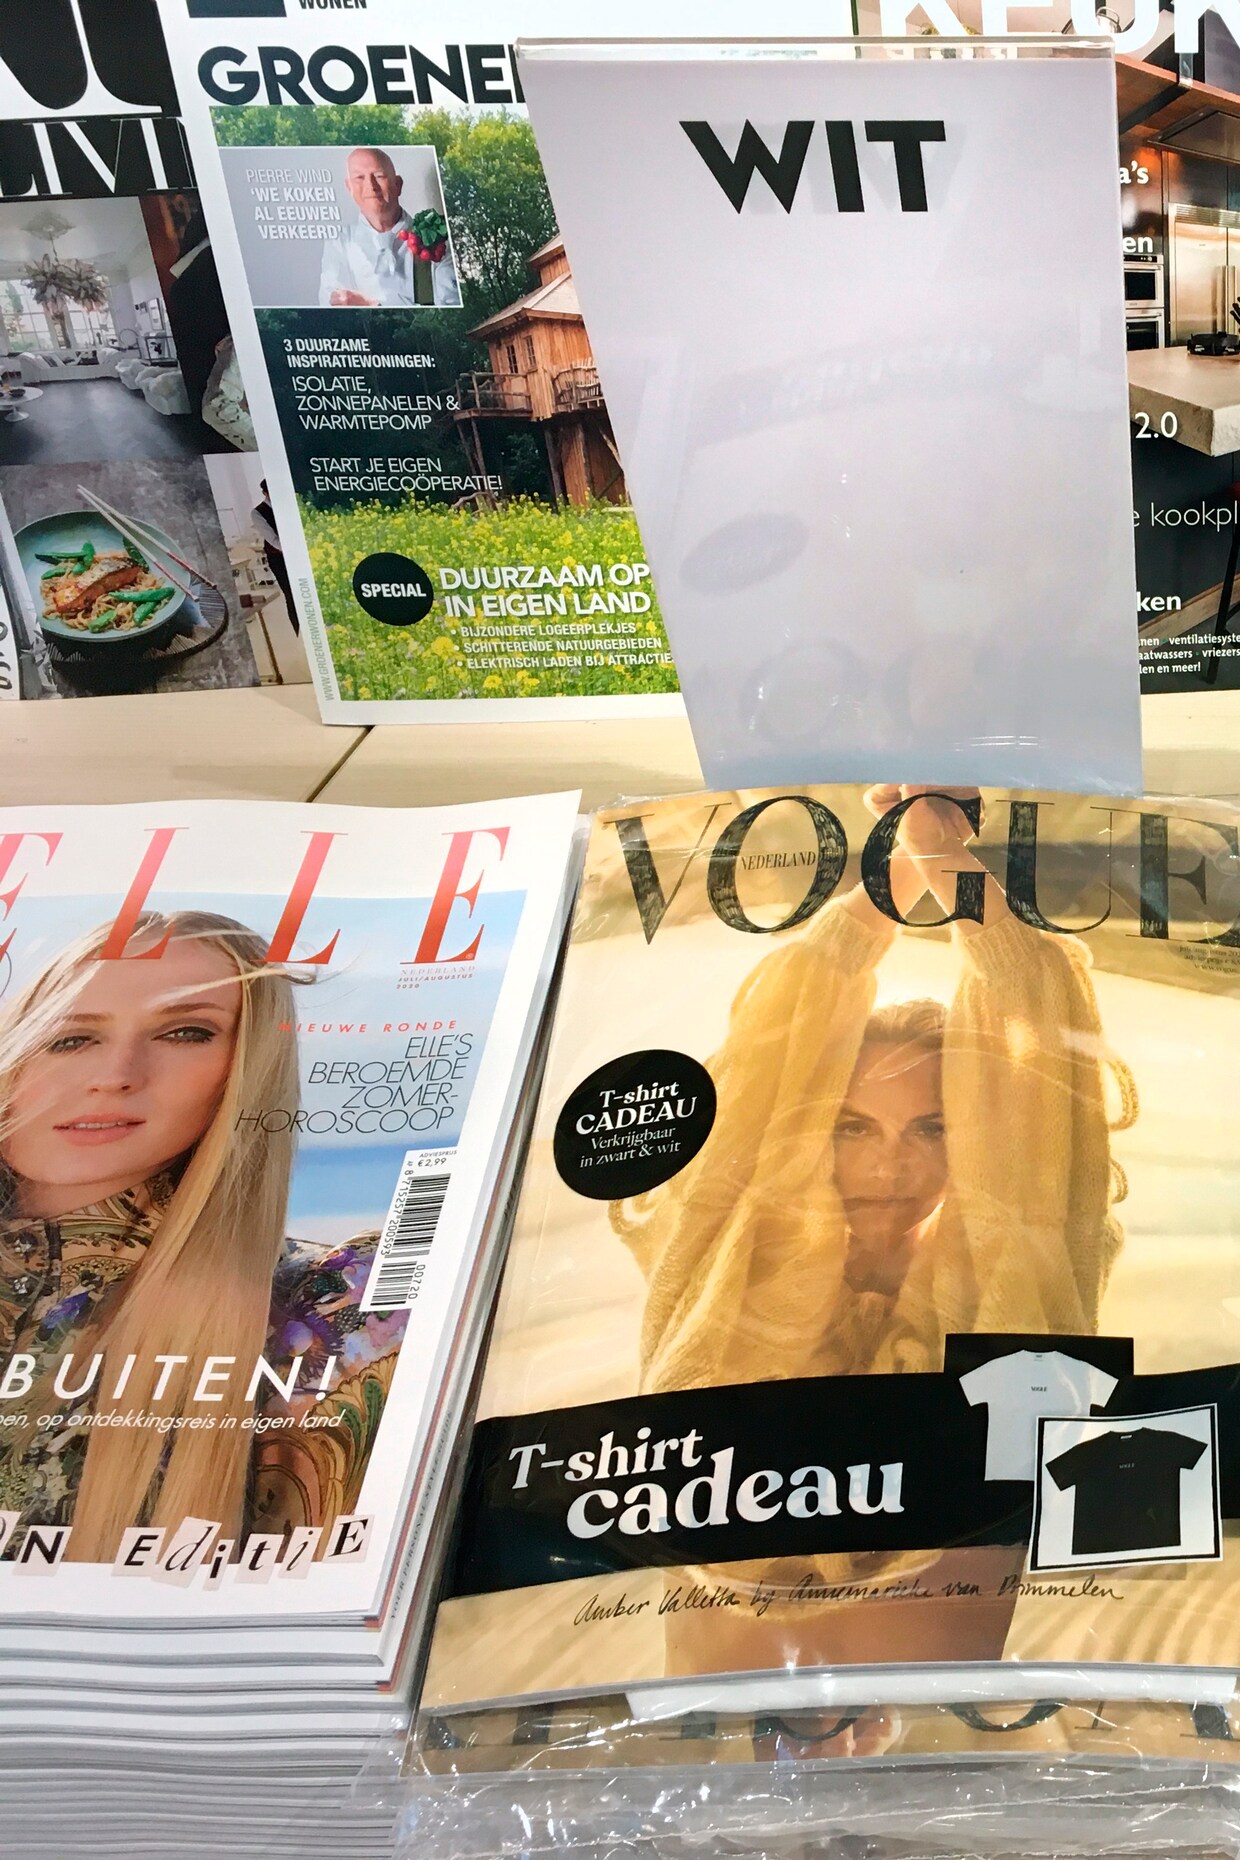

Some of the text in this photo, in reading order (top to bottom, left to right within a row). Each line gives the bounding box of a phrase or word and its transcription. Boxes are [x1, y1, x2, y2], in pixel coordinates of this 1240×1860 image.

[198, 45, 527, 105] GROENE
[246, 169, 333, 183] PIERRE WIND
[678, 118, 946, 214] WIT
[283, 187, 336, 202] KOKEN
[254, 206, 341, 221] AL EEUWEN
[284, 339, 370, 352] 3 DUURZAME
[287, 354, 436, 368] INSPIRATIEWONINGEN:
[292, 376, 372, 393] ISOLATIE,
[295, 395, 460, 411] ZONNEPANELEN &
[299, 414, 432, 430] WARMTEPOMP
[1134, 411, 1178, 439] 2.0
[310, 457, 442, 473] START JE EIGEN
[314, 473, 503, 491] ENERGIECOÖPERATIE!
[439, 564, 651, 590] DUURZAAM OP
[361, 583, 427, 598] SPECIAL
[445, 591, 652, 617] IN EIGEN LAND
[299, 578, 334, 701] WWW.GROENERWONEN.COM
[461, 622, 636, 637] BIJZONDERE LOGEERPLEKJES
[464, 637, 662, 653] SCHITTERENDE NATUURGEBIEDEN
[1202, 647, 1240, 658] vriezers
[467, 654, 604, 669] ELEKTRISCH LADEN BIJ
[1157, 662, 1201, 674] en meer!
[740, 850, 816, 873] NEDERLAND
[398, 973, 474, 983] JULI/AUGUSTUS
[400, 965, 477, 975] NEDERLAND
[278, 1020, 457, 1033] NIEUWE RONDE
[404, 1033, 474, 1059] ELLE'S
[308, 1057, 469, 1084] BEROEMDE
[341, 1082, 459, 1109] ZOMER-
[599, 1082, 680, 1109] T-shirt
[234, 1106, 455, 1134] HOROSCOOP
[575, 1097, 697, 1136] CADEAU
[591, 1127, 676, 1151] Verkrijgbaar
[580, 1140, 681, 1168] in zwart & wit
[0, 1353, 337, 1402] BUITEN!
[37, 1408, 346, 1434] op ontdekkingsreis in eigen land
[509, 1425, 705, 1492] T-shirt
[566, 1447, 906, 1540] cadeau
[750, 1580, 776, 1617] by
[941, 1580, 983, 1598] van
